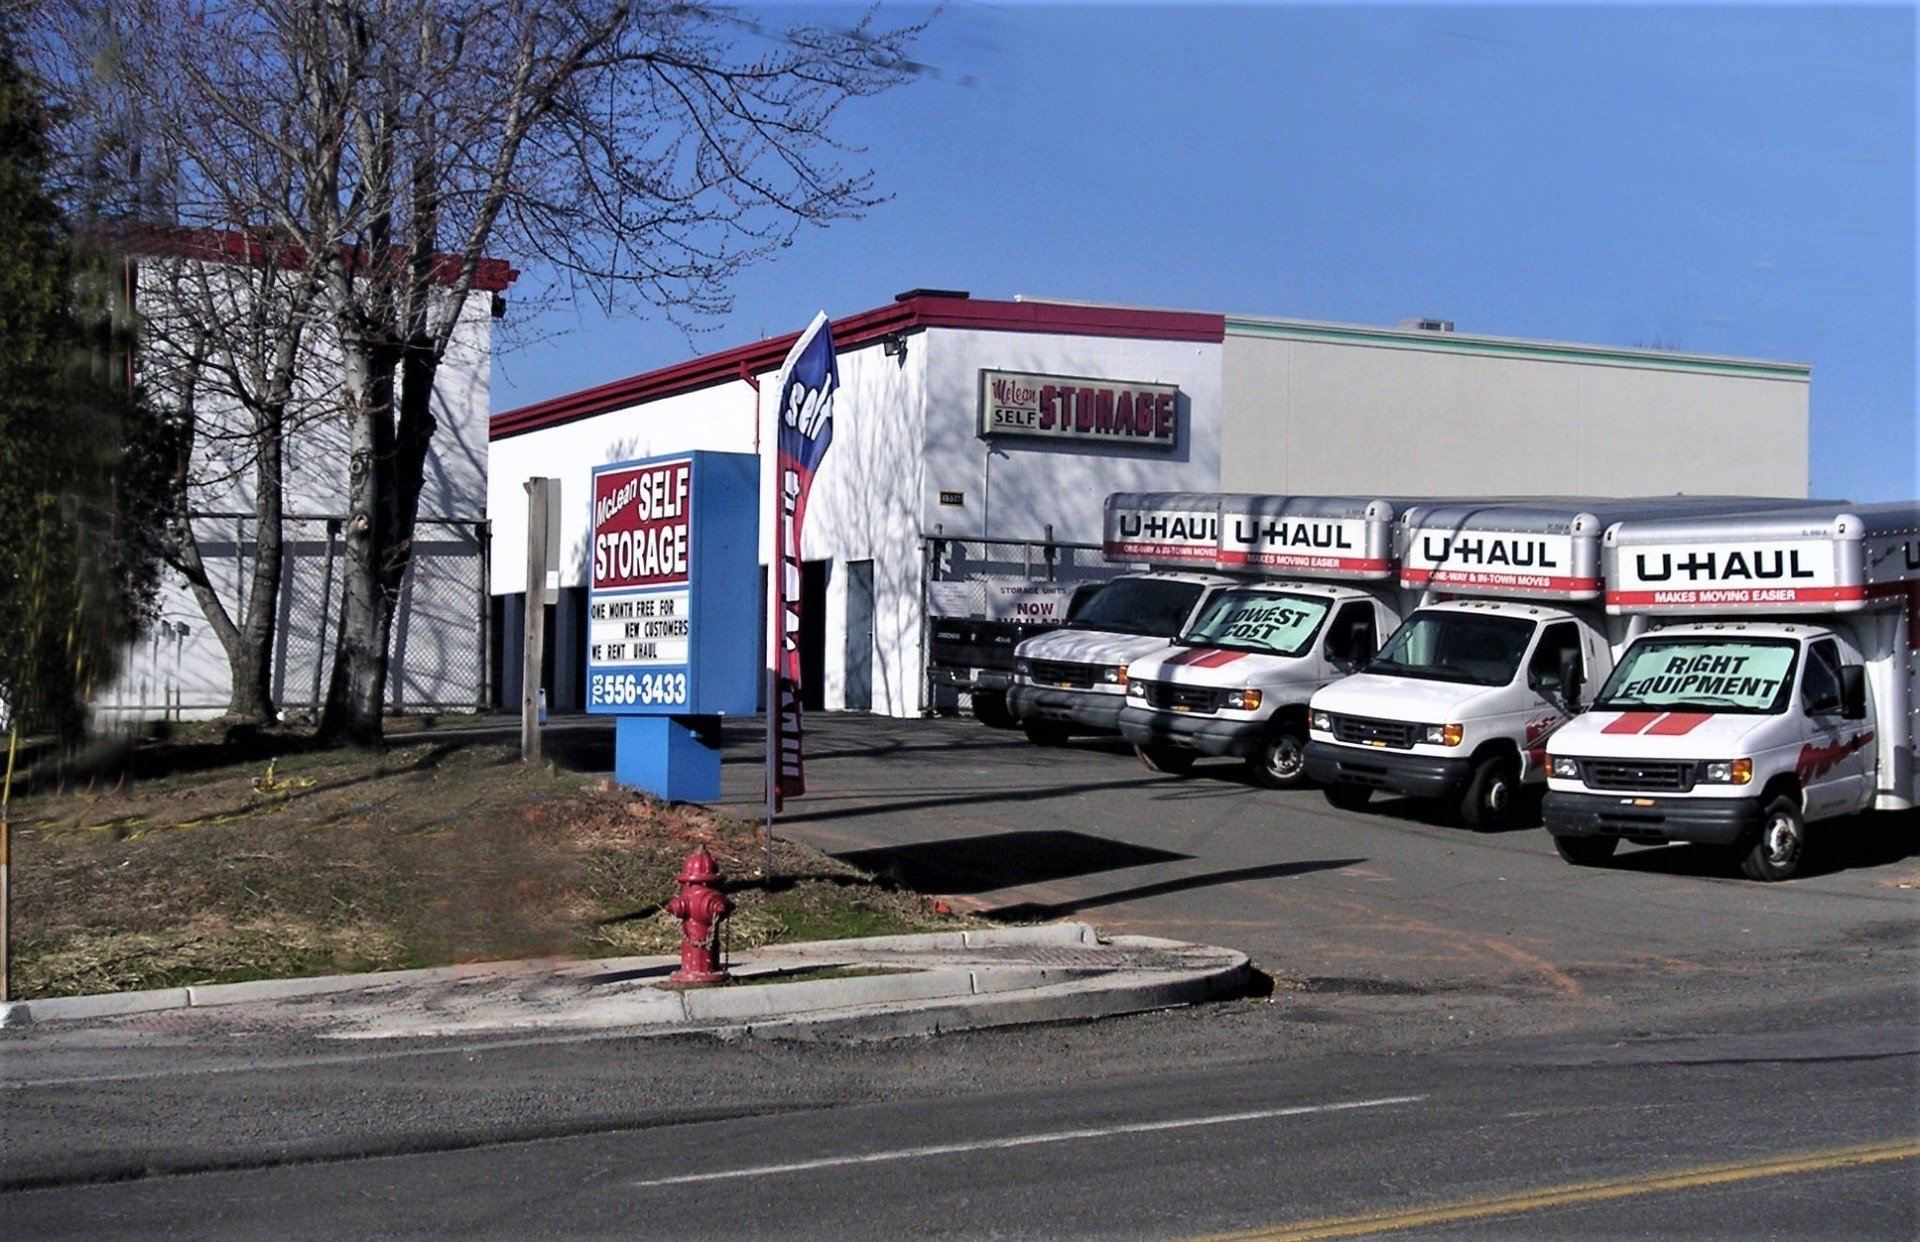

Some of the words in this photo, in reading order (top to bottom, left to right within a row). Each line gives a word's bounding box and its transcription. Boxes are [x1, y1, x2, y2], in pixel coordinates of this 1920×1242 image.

[992, 379, 1037, 405] McLean
[995, 410, 1036, 425] SELF
[1040, 385, 1174, 439] STORAGE
[597, 478, 638, 527] McLean
[638, 467, 689, 523] SELF
[1120, 515, 1217, 540] U-HAUL
[1236, 521, 1352, 549] U-HAUL
[595, 525, 687, 581] STORAGE
[1246, 554, 1274, 562] MAKES
[1276, 556, 1310, 566] MOVING
[1311, 559, 1340, 567] EASIER
[1424, 537, 1556, 567] U-HAUL
[1637, 550, 1814, 581] U-HAUL
[1429, 571, 1468, 581] ONE-WAY
[1477, 574, 1516, 585] IN-TOWN
[1517, 576, 1550, 587] MOVES
[1000, 587, 1039, 595] STORAGE
[1042, 587, 1067, 595] UNITS
[1654, 591, 1697, 603] MAKES
[1699, 590, 1750, 602] MOVING
[1752, 589, 1796, 601] EASIER
[592, 604, 606, 619] ONE
[609, 602, 634, 618] MONTH
[636, 600, 655, 617] FREE
[660, 599, 675, 616] FOR
[1017, 603, 1054, 615] NOW
[1219, 607, 1310, 628] LOWEST
[625, 622, 640, 638] NEW
[644, 619, 689, 637] CUSTOMERS
[1220, 624, 1280, 640] COST
[592, 645, 602, 660] WE
[607, 644, 626, 659] RENT
[633, 643, 658, 659] UHAUL
[1665, 655, 1750, 675] RIGHT
[592, 674, 604, 705] 703
[604, 673, 687, 705] 556-3433
[1622, 676, 1780, 699] EQUIPMENT
